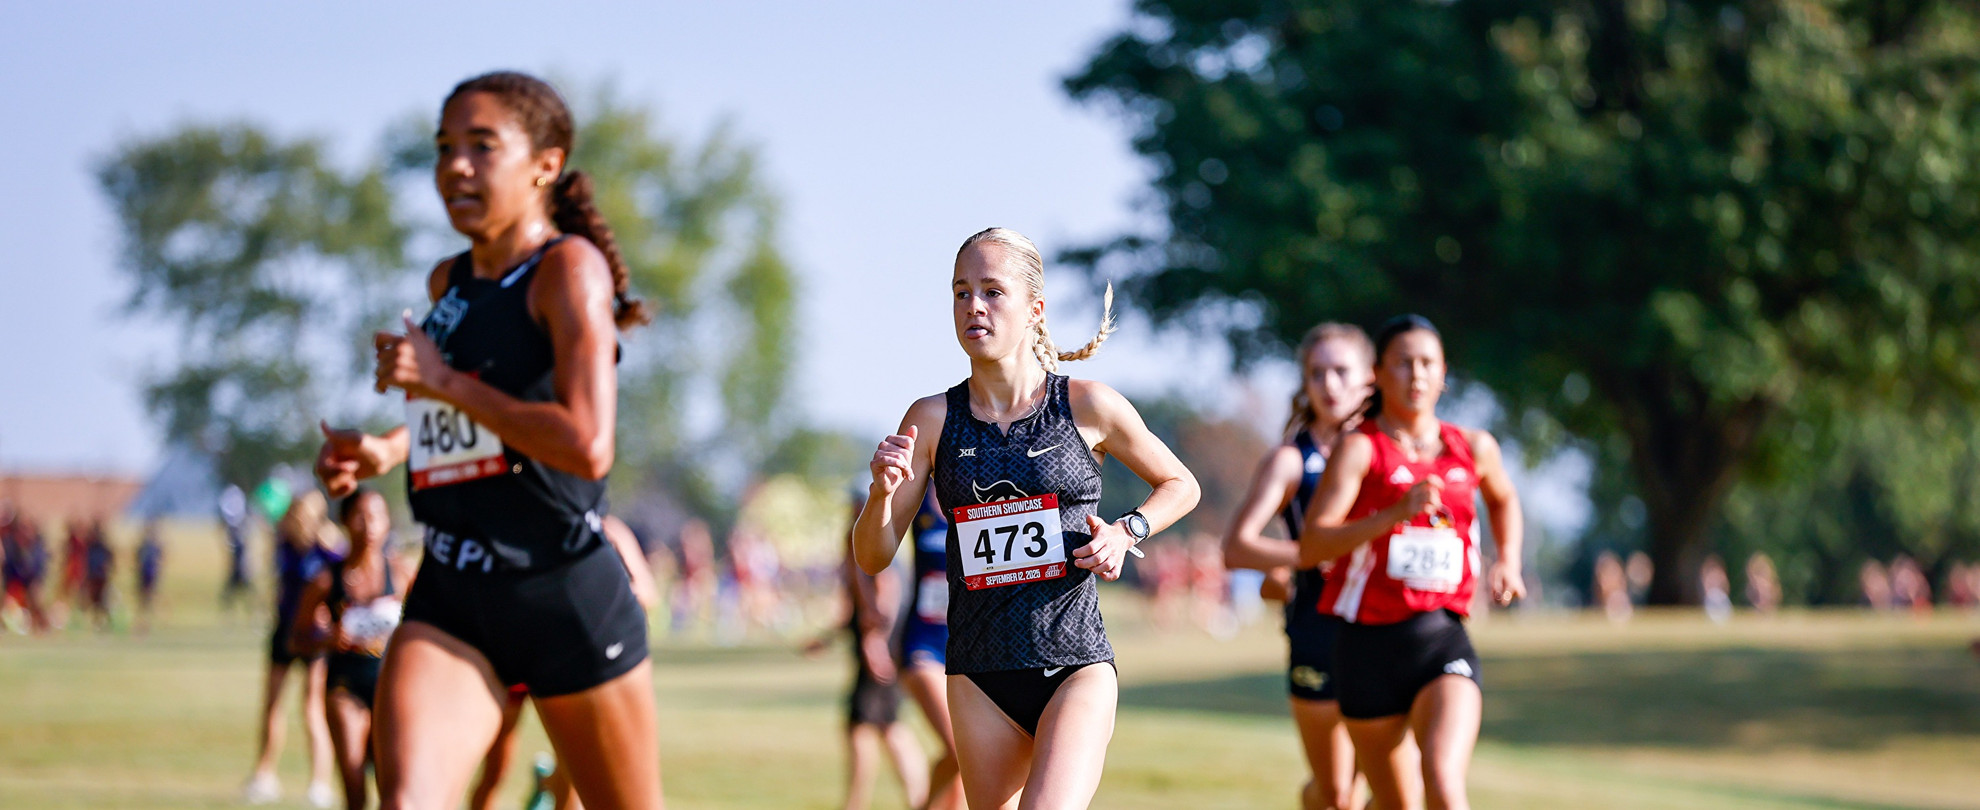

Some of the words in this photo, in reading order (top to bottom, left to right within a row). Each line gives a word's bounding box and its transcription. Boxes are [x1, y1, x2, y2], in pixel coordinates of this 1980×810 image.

[419, 409, 477, 454] 480
[958, 447, 976, 457] XII
[967, 504, 1002, 519] SOUTHERN
[1002, 498, 1043, 514] SHOWCASE
[973, 521, 1048, 564] 473
[1402, 544, 1451, 574] 284
[985, 573, 1017, 586] SEPTEMBER
[1026, 569, 1041, 579] 2025
